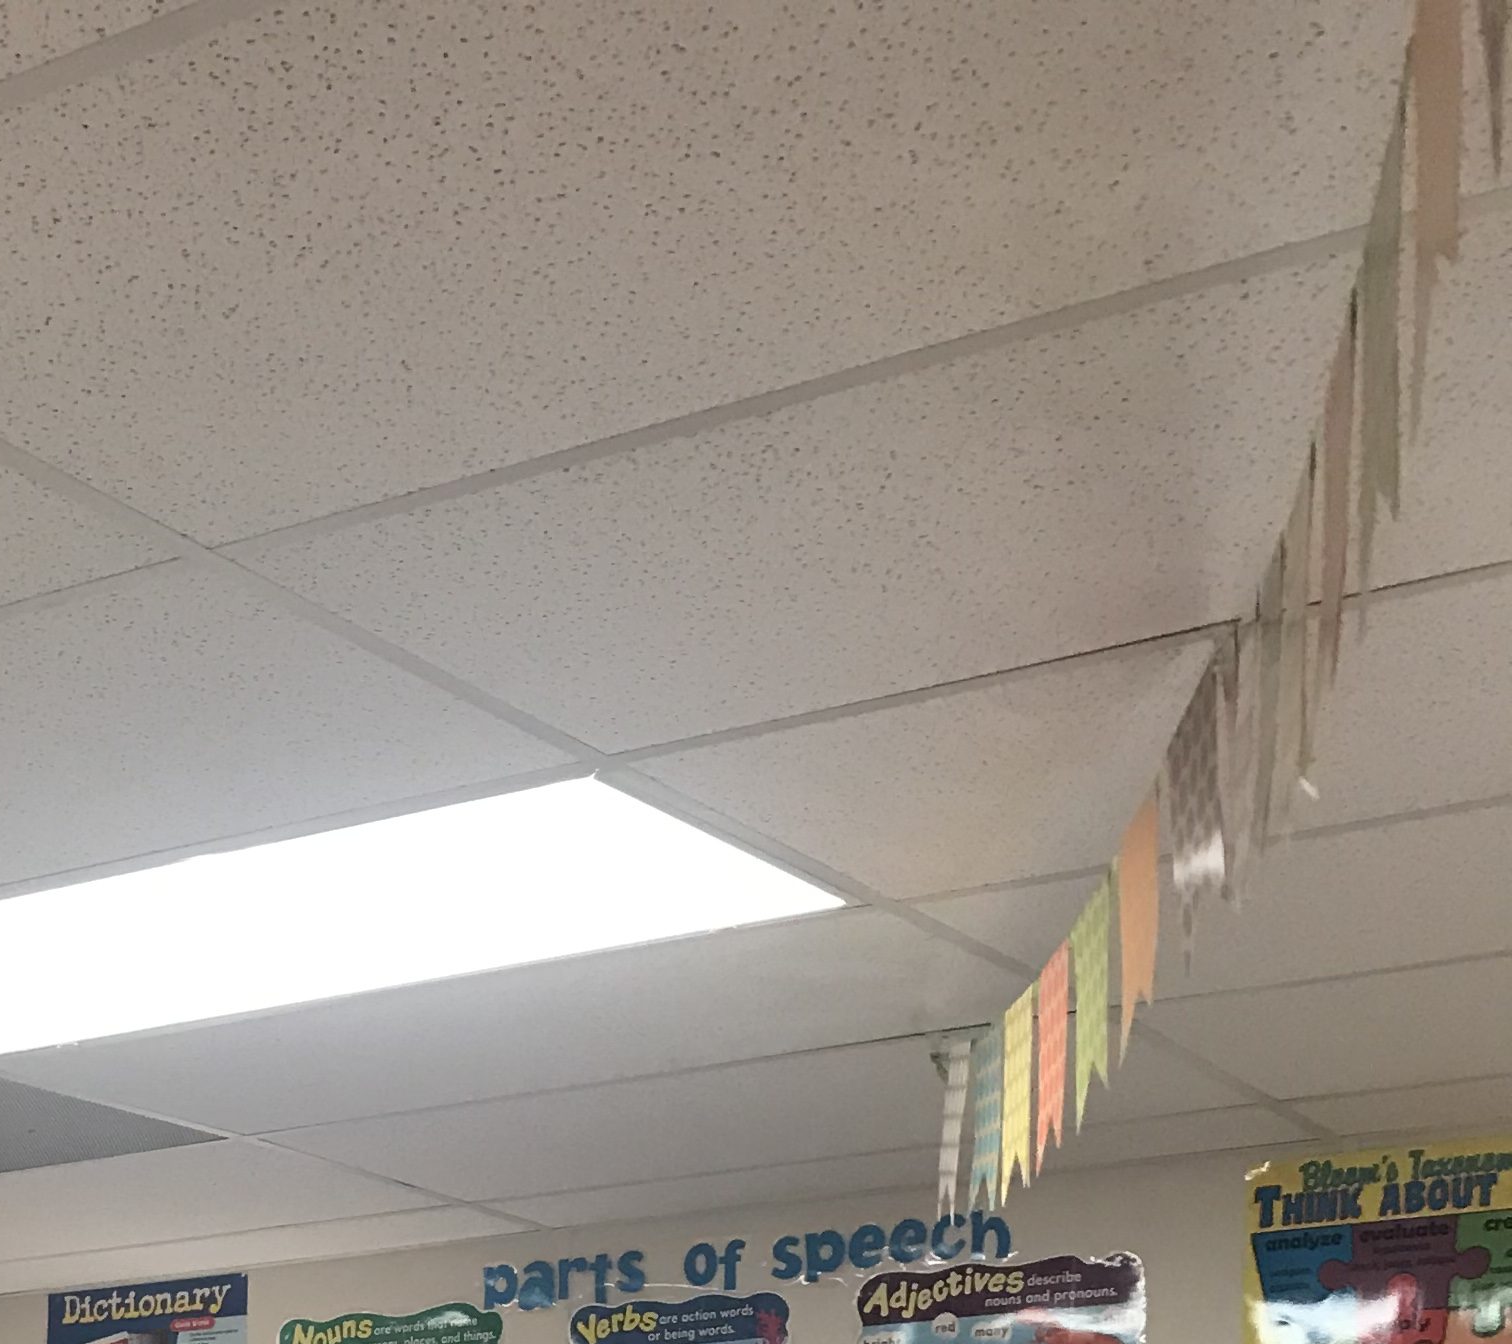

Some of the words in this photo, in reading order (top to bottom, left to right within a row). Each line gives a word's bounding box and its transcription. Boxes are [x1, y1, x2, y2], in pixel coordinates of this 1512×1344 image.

[1409, 1149, 1512, 1182] Taxonom
[1254, 1184, 1363, 1230] THINK
[1379, 1172, 1498, 1218] ABOUT
[1265, 1230, 1343, 1252] analyze
[1359, 1221, 1449, 1243] evaluate
[482, 1249, 645, 1310] parts
[683, 1239, 746, 1290] of
[771, 1209, 1012, 1283] speech
[61, 1282, 232, 1326] Dictionary
[862, 1267, 1026, 1320] Adjectives
[1027, 1271, 1083, 1288] describe
[984, 1296, 1022, 1308] nouns
[1025, 1289, 1050, 1304] and
[1053, 1286, 1118, 1303] pronouns.
[659, 1314, 678, 1326] are
[681, 1309, 717, 1323] action
[720, 1304, 755, 1318] words
[392, 1321, 425, 1333] words
[441, 1332, 461, 1344] and
[647, 1331, 661, 1343] or
[664, 1326, 696, 1343] being
[935, 1321, 957, 1335] red
[974, 1327, 1010, 1340] many
